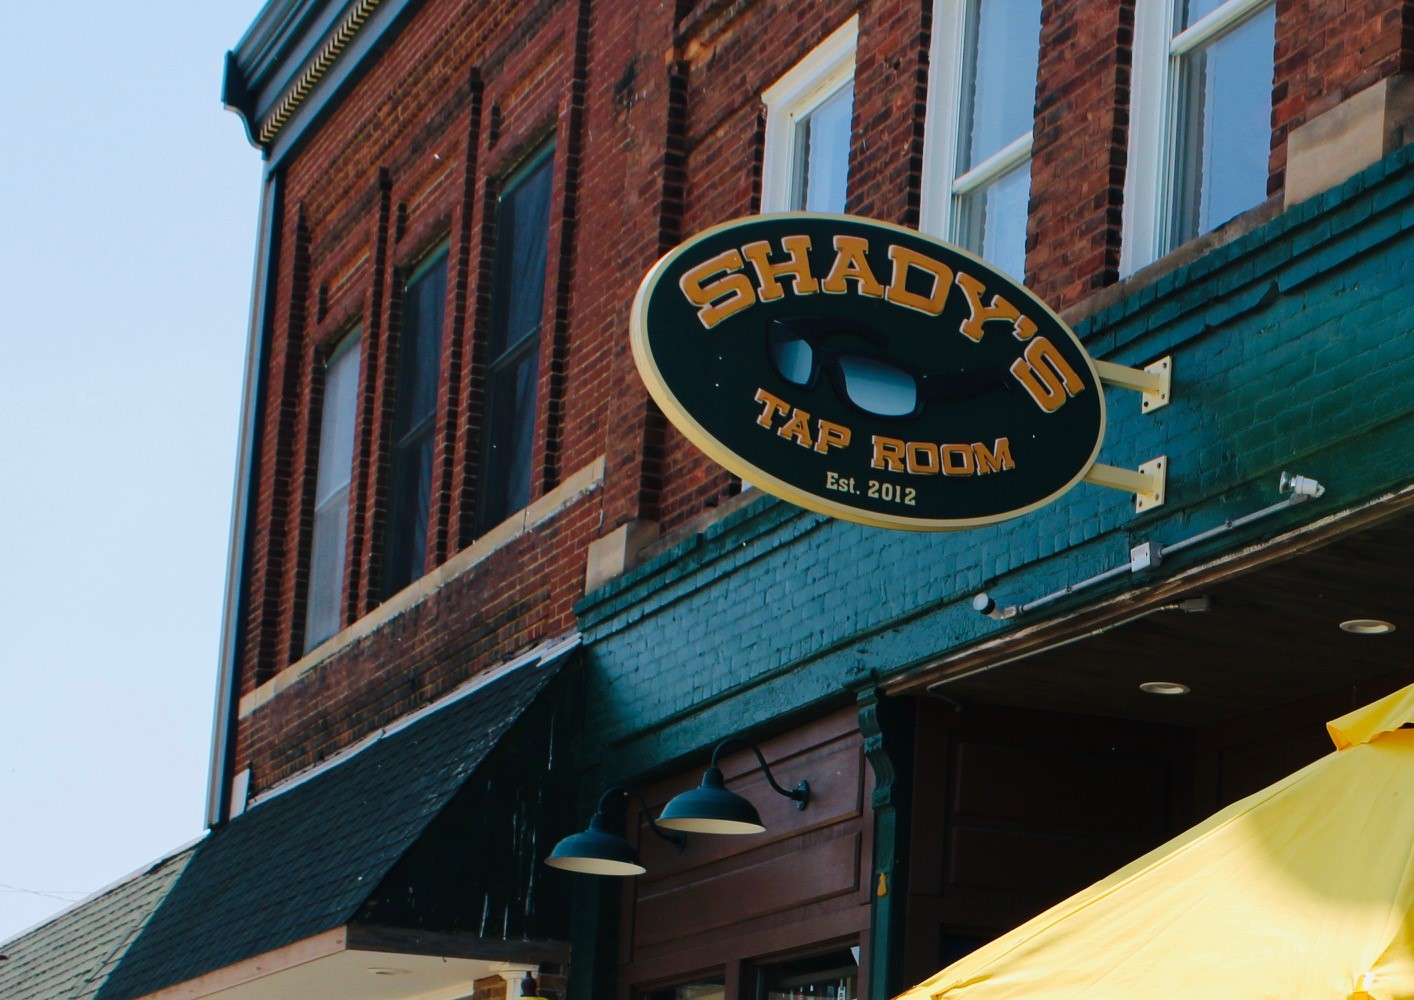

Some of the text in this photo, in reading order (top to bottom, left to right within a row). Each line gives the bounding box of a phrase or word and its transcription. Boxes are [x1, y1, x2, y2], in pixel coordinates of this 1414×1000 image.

[679, 235, 1085, 413] SHADY'S
[754, 389, 1016, 477] TAP ROOM
[826, 471, 917, 506] Est. 2012
